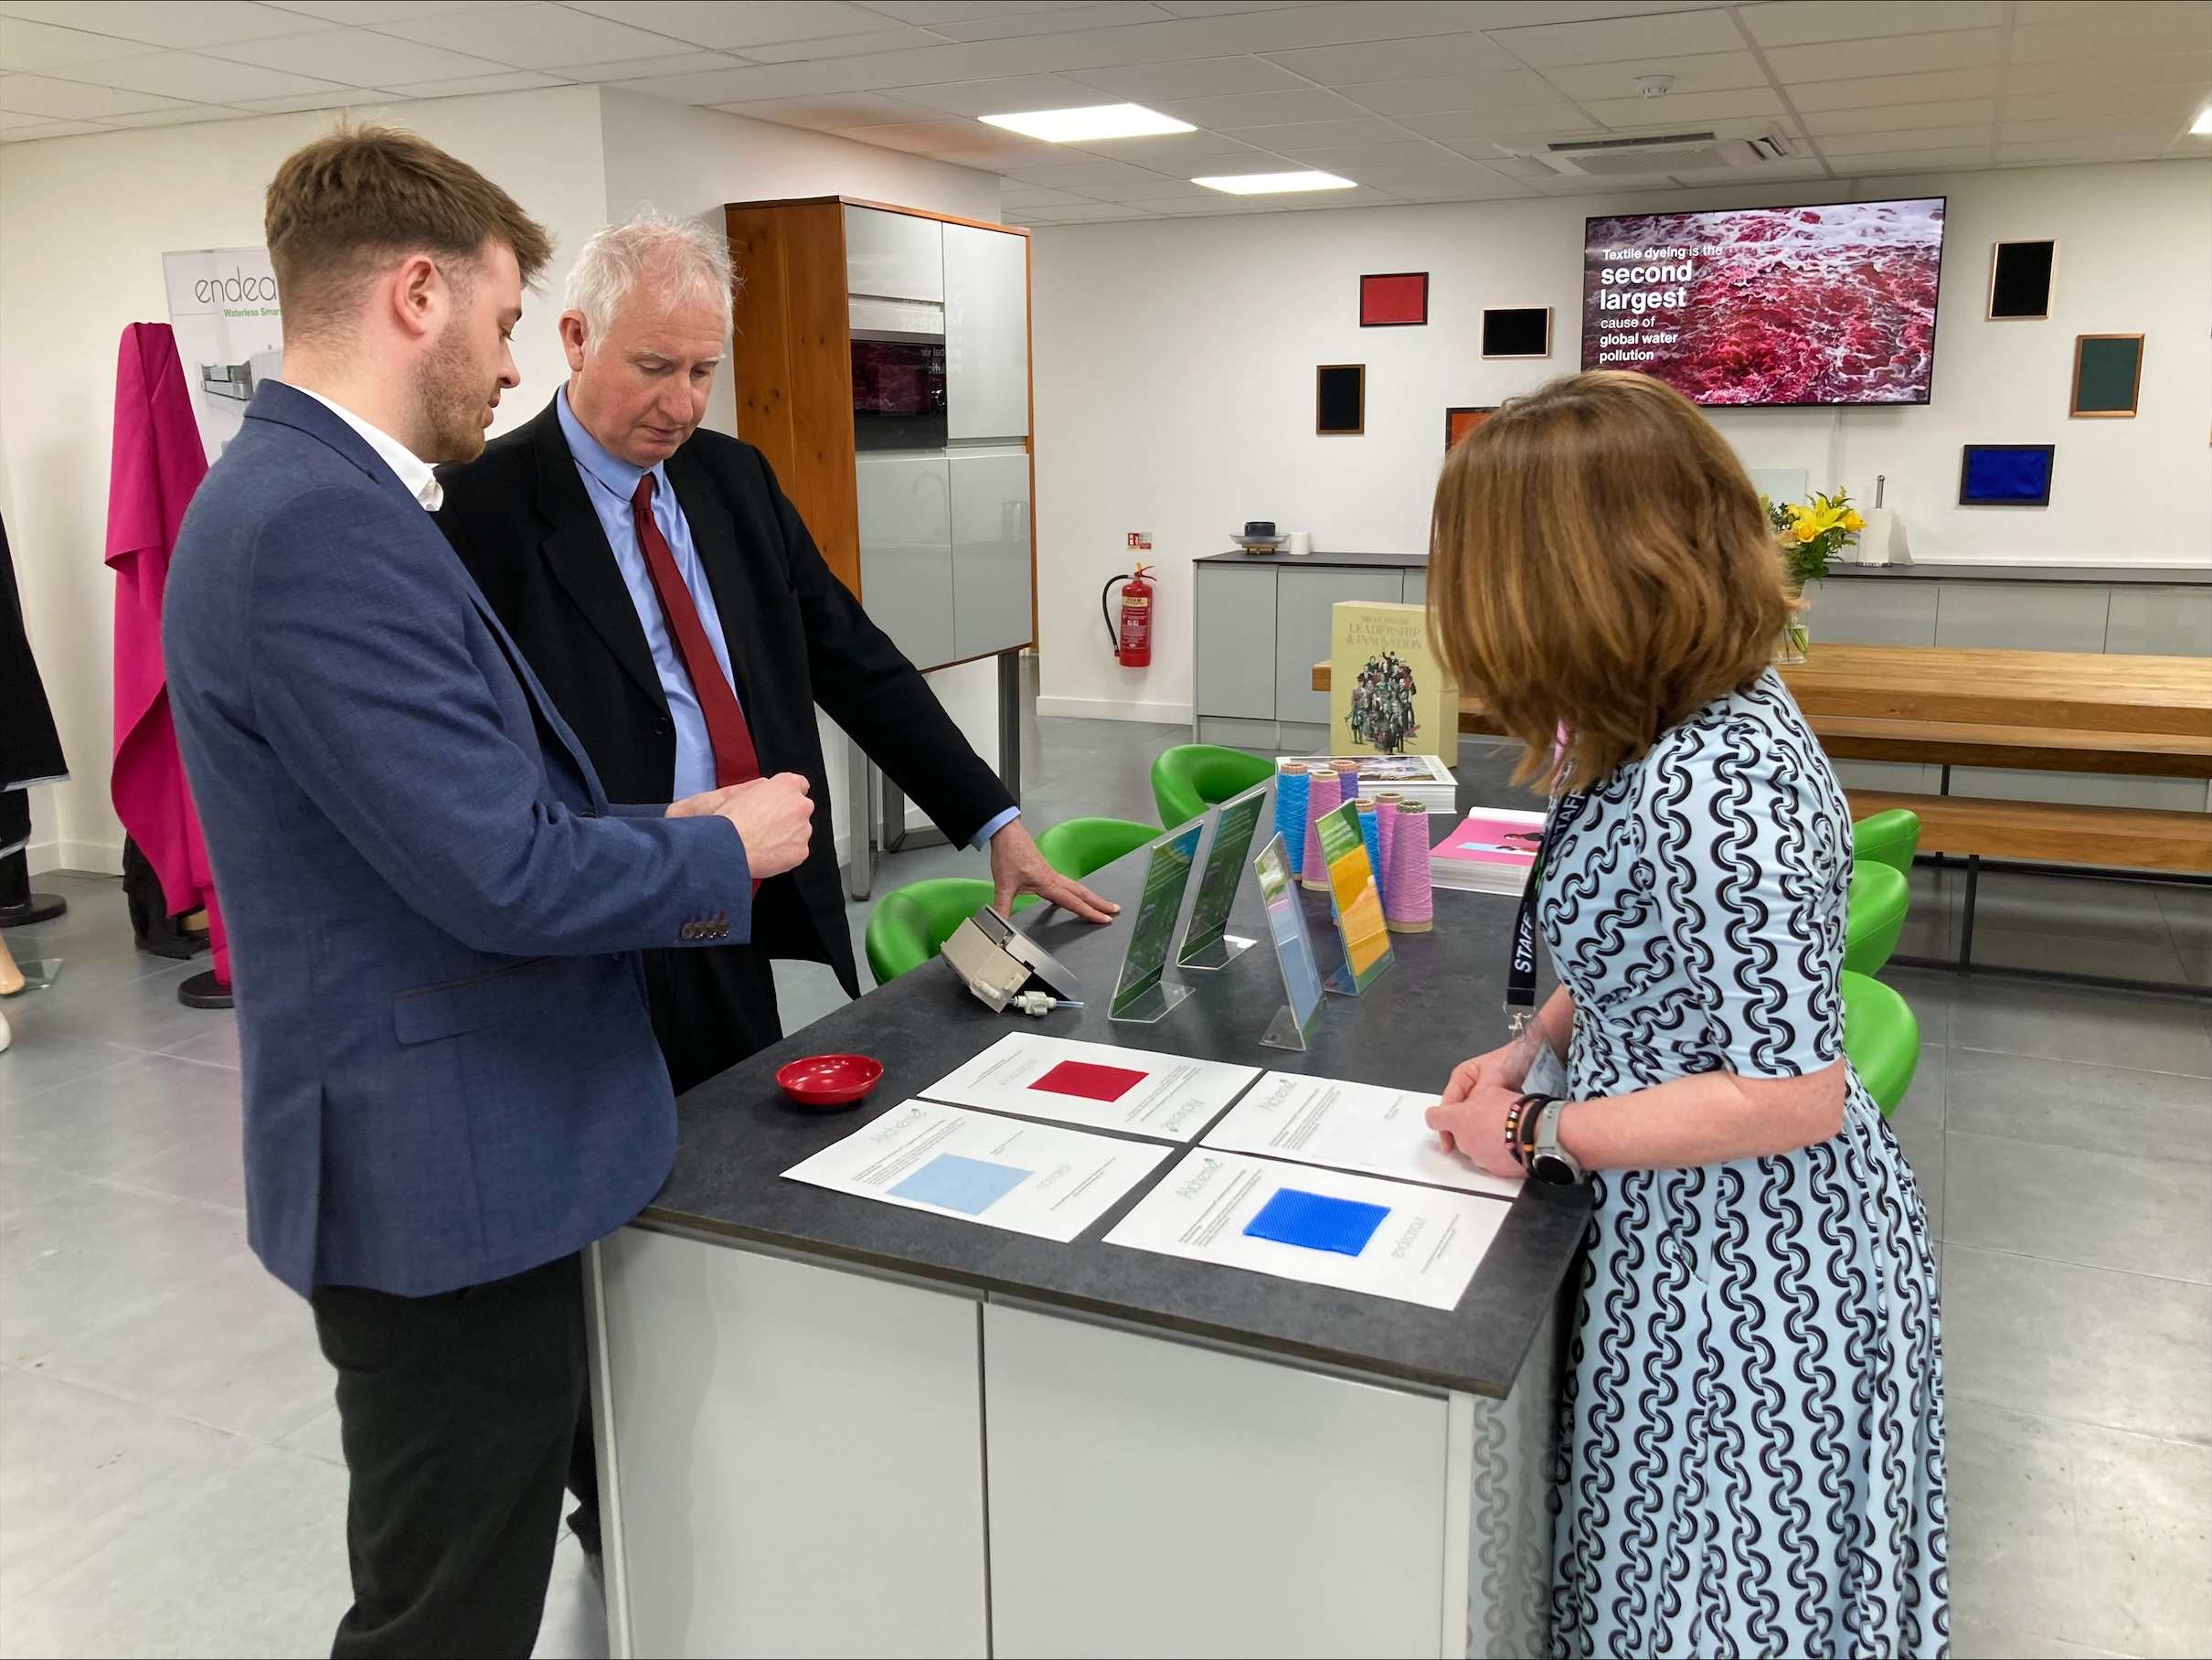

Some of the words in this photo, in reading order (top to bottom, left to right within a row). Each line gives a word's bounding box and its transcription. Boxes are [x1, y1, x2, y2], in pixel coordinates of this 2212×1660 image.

[1602, 248, 1642, 261] Textile
[1644, 245, 1686, 261] dyeing
[1688, 246, 1700, 257] is
[1702, 244, 1723, 257] the
[1601, 261, 1692, 284] second
[1600, 287, 1686, 314] largest
[223, 307, 260, 318] Waterless
[1600, 319, 1639, 330] cause
[1642, 316, 1655, 328] of
[1600, 333, 1639, 347] global
[1641, 332, 1678, 345] water
[1600, 349, 1654, 364] pollution
[1514, 911, 1533, 974] STAFF
